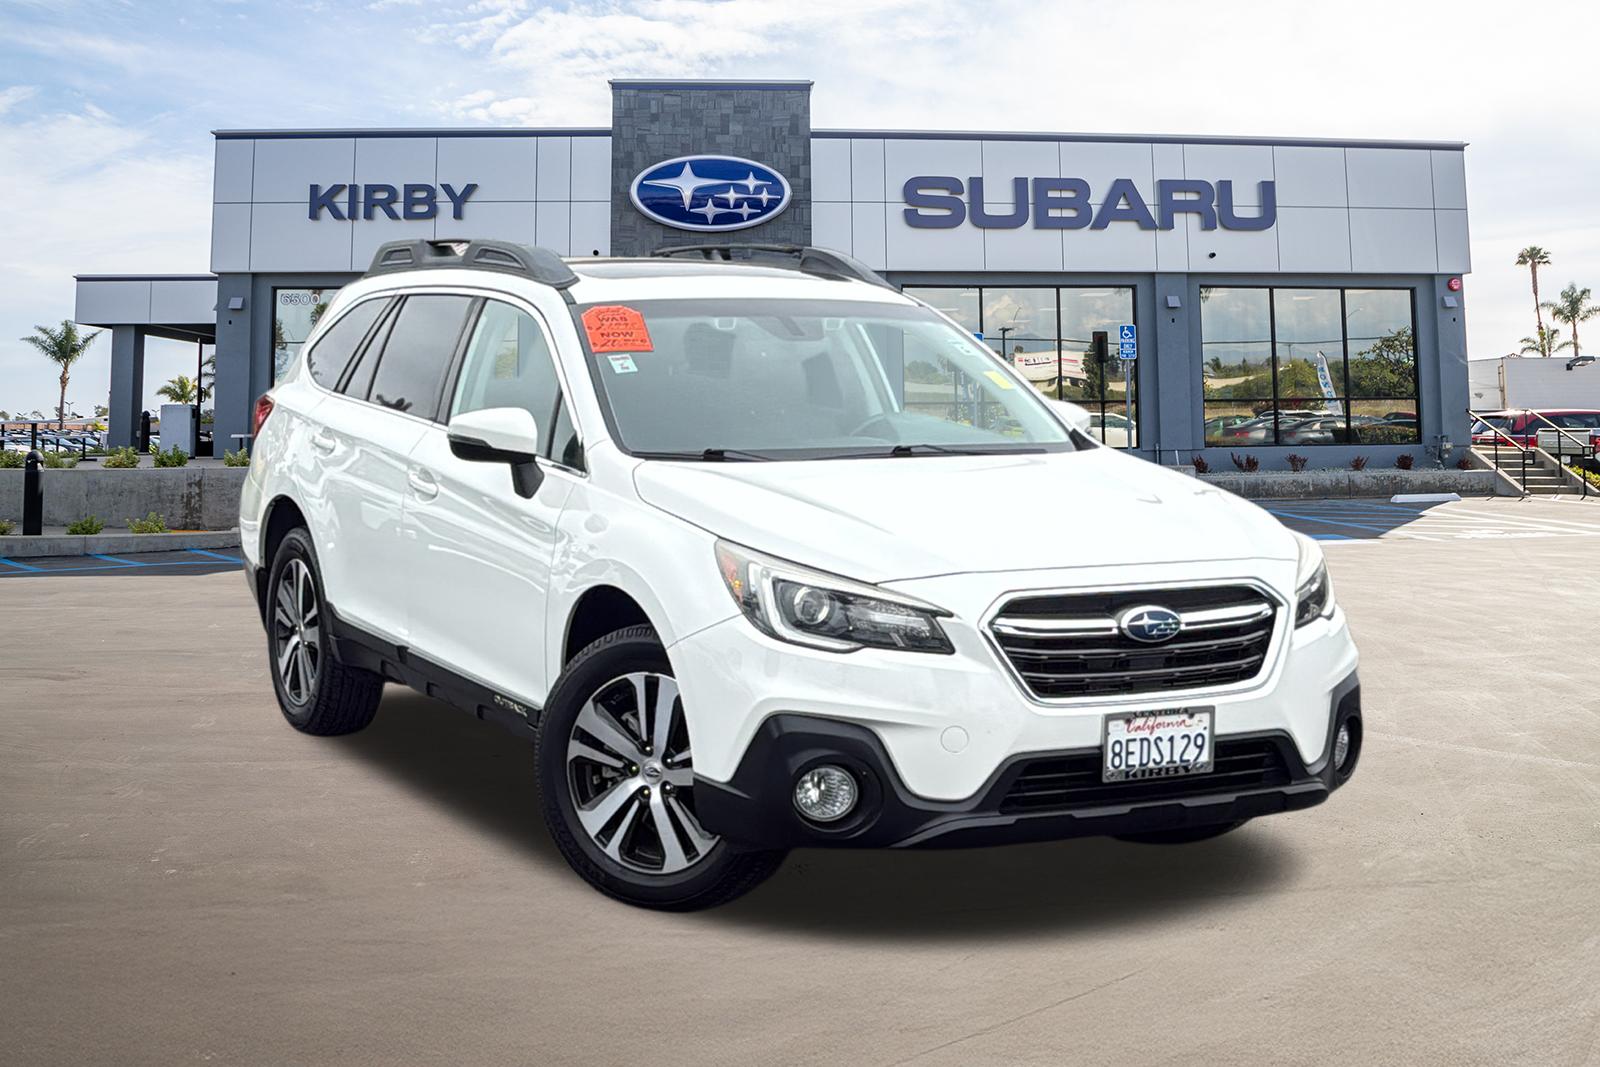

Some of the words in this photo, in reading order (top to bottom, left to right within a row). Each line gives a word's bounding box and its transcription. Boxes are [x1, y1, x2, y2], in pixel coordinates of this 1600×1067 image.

[308, 183, 478, 220] KIRBY
[903, 175, 1276, 231] SUBARU
[1126, 717, 1193, 735] California
[1111, 732, 1206, 769] 8EDS129
[1125, 765, 1191, 779] KIRBY
